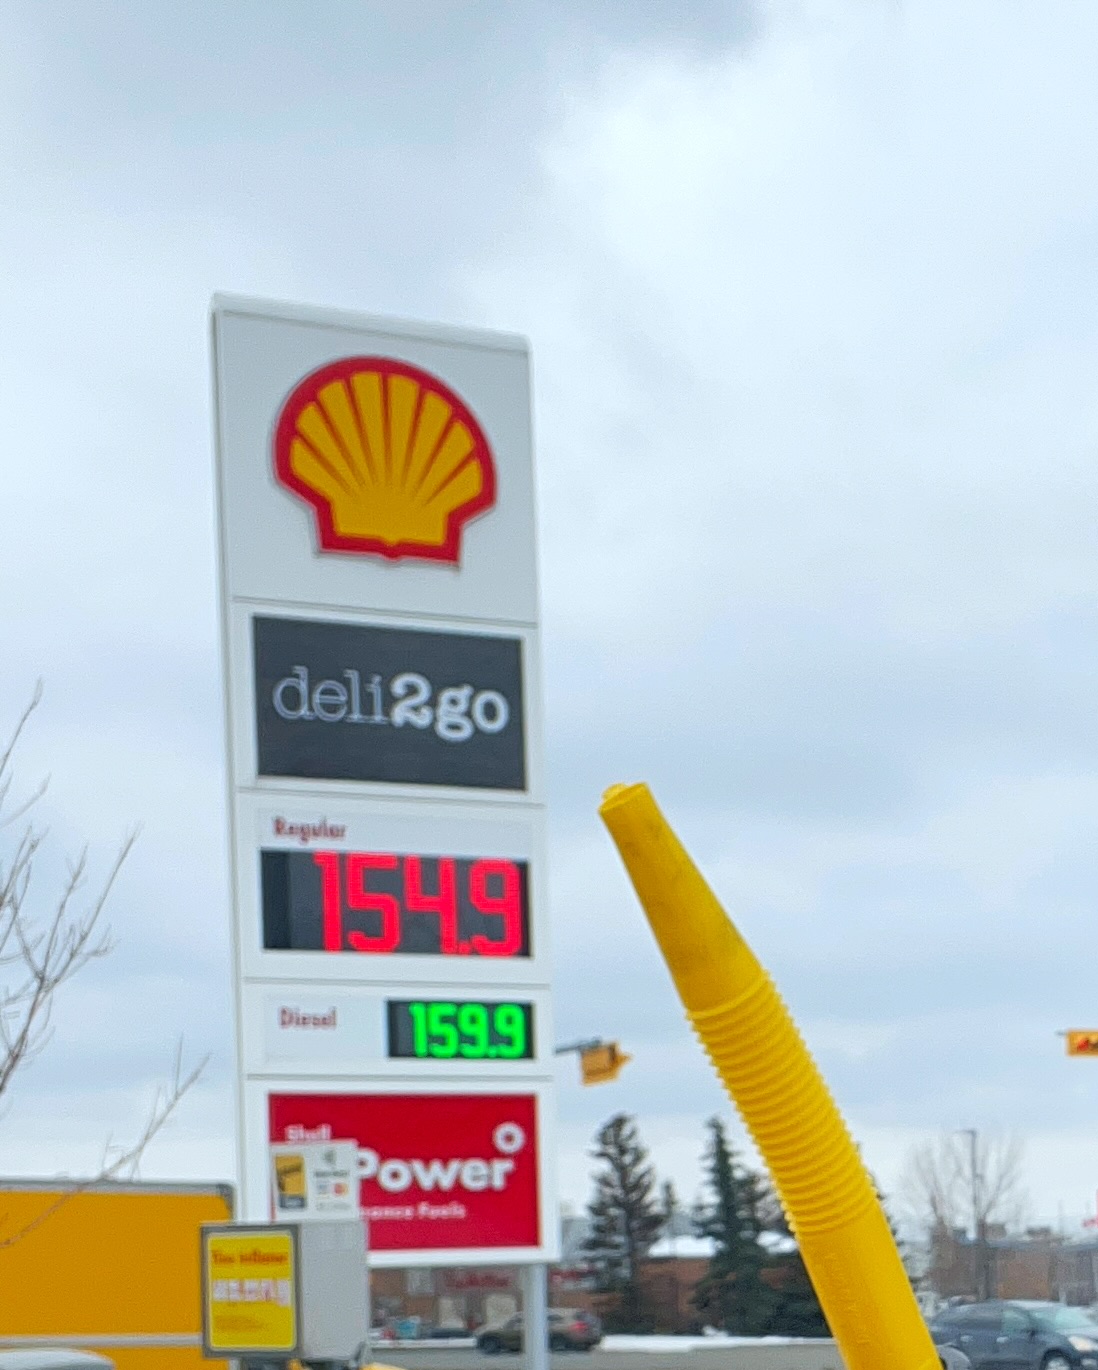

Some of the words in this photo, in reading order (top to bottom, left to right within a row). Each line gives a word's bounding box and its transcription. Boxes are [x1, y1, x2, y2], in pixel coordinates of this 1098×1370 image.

[272, 665, 510, 742] deli2go
[274, 815, 346, 844] Regular
[313, 850, 522, 957] 154.9
[279, 1006, 337, 1030] Diesel
[409, 1002, 525, 1059] 159.9
